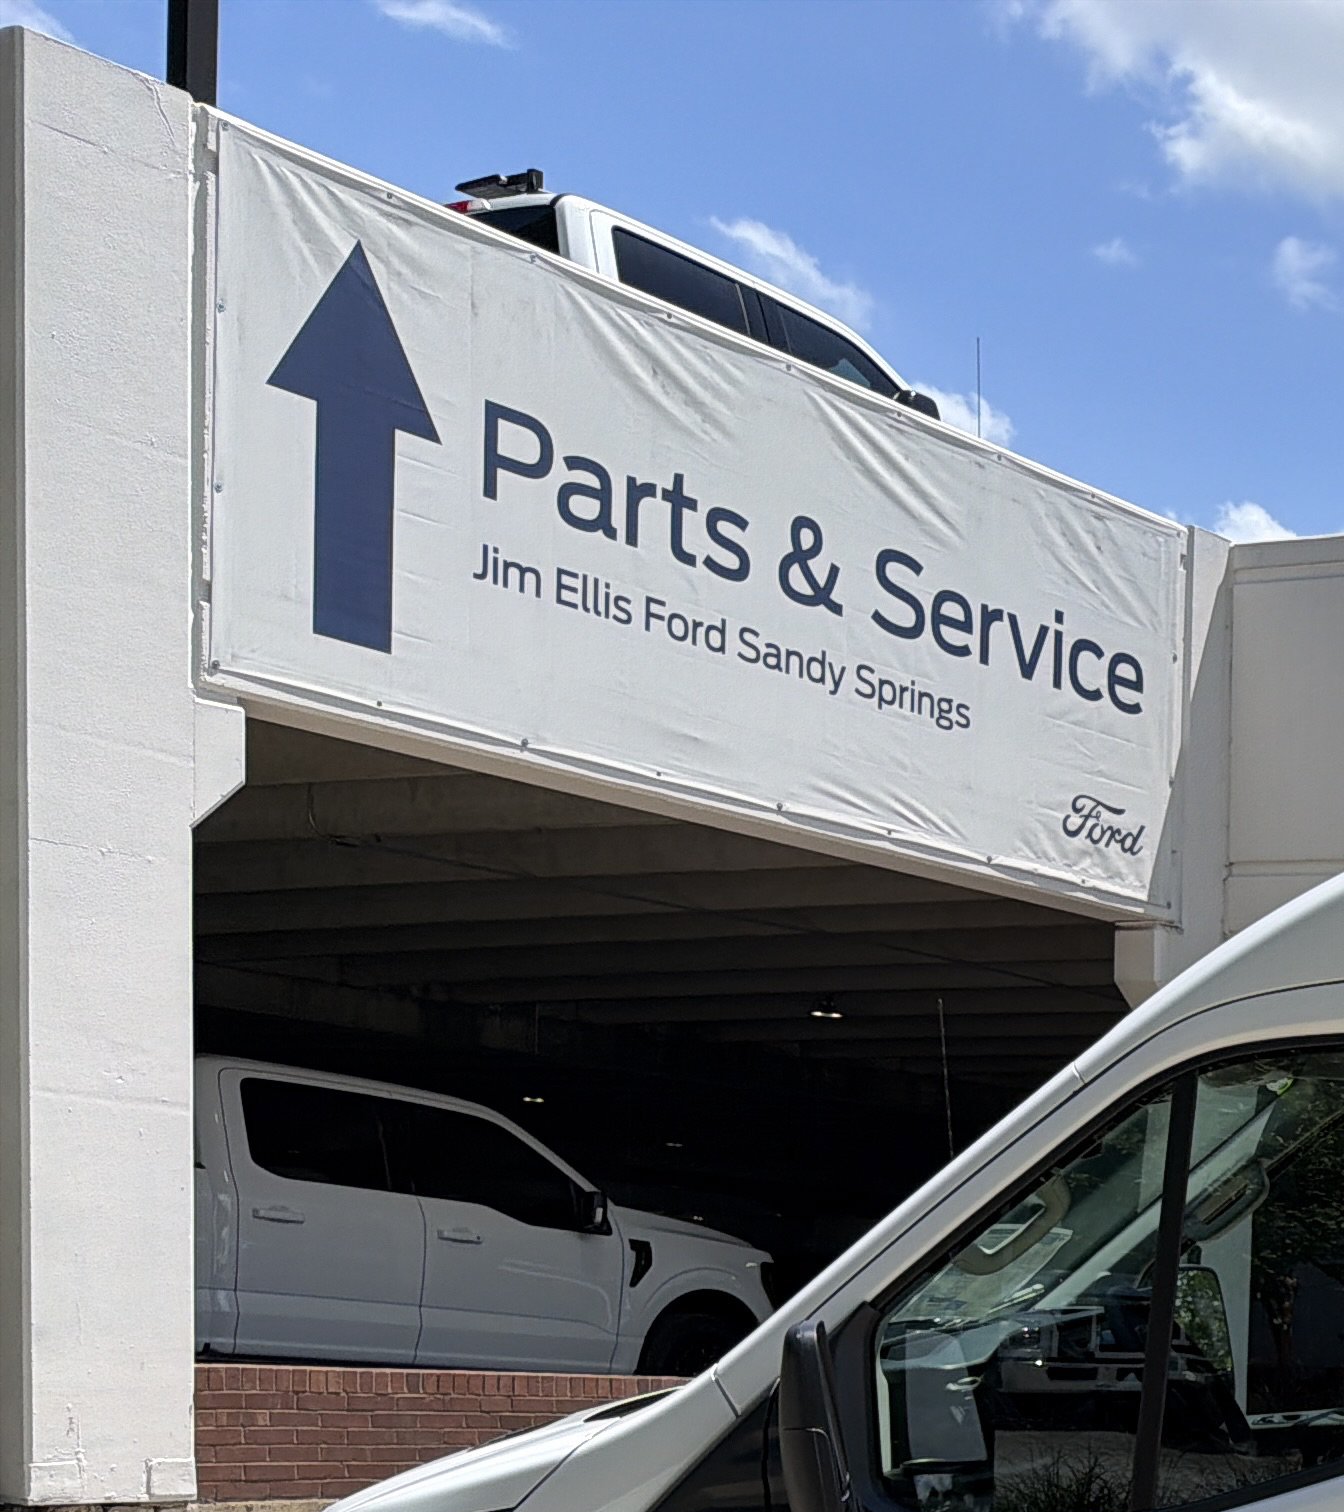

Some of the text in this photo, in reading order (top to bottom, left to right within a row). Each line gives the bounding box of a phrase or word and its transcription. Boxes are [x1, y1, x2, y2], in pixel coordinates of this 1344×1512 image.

[472, 543, 972, 732] Jim Ellis Ford Sandy Springs
[482, 398, 1144, 715] Parts & Service
[1061, 794, 1146, 857] Ford
